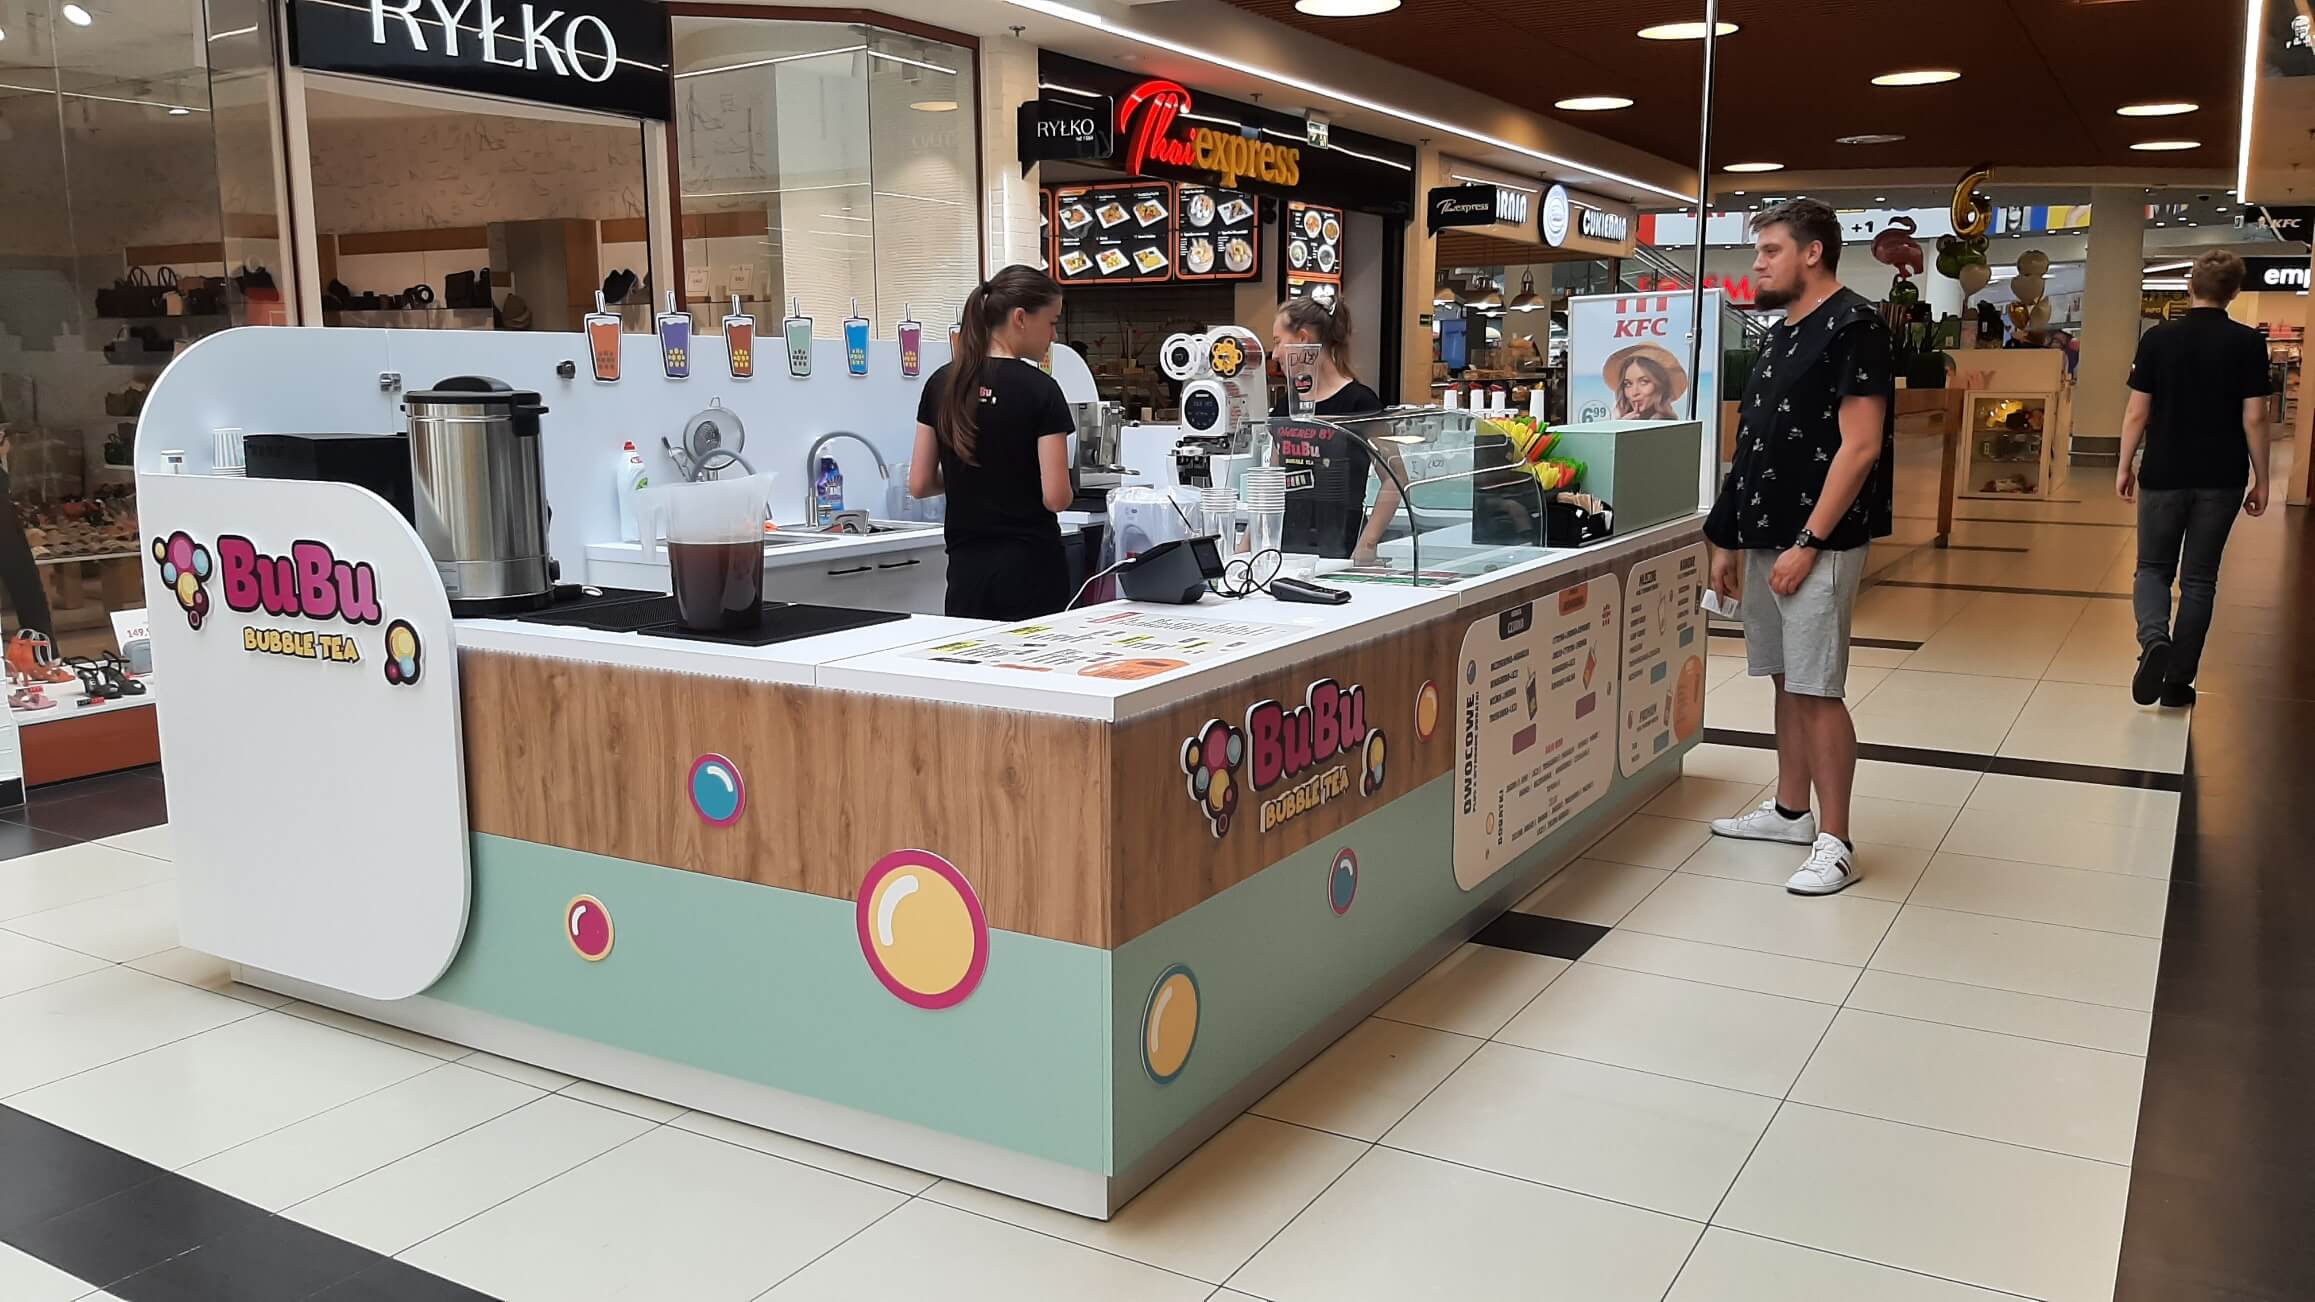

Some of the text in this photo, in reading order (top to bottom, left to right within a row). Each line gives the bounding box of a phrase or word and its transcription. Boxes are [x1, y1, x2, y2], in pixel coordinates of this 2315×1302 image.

[371, 0, 617, 82] RYŁKO
[1037, 118, 1095, 137] RYŁKO
[1613, 317, 1669, 338] KFC
[1282, 440, 1320, 458] BuBu
[217, 534, 382, 626] BuBu
[243, 626, 361, 663] BUBBLE TEA
[1247, 678, 1367, 791] BuBu
[1463, 693, 1475, 815] OWOCOWE
[1262, 765, 1350, 832] BUBBLE TEA
